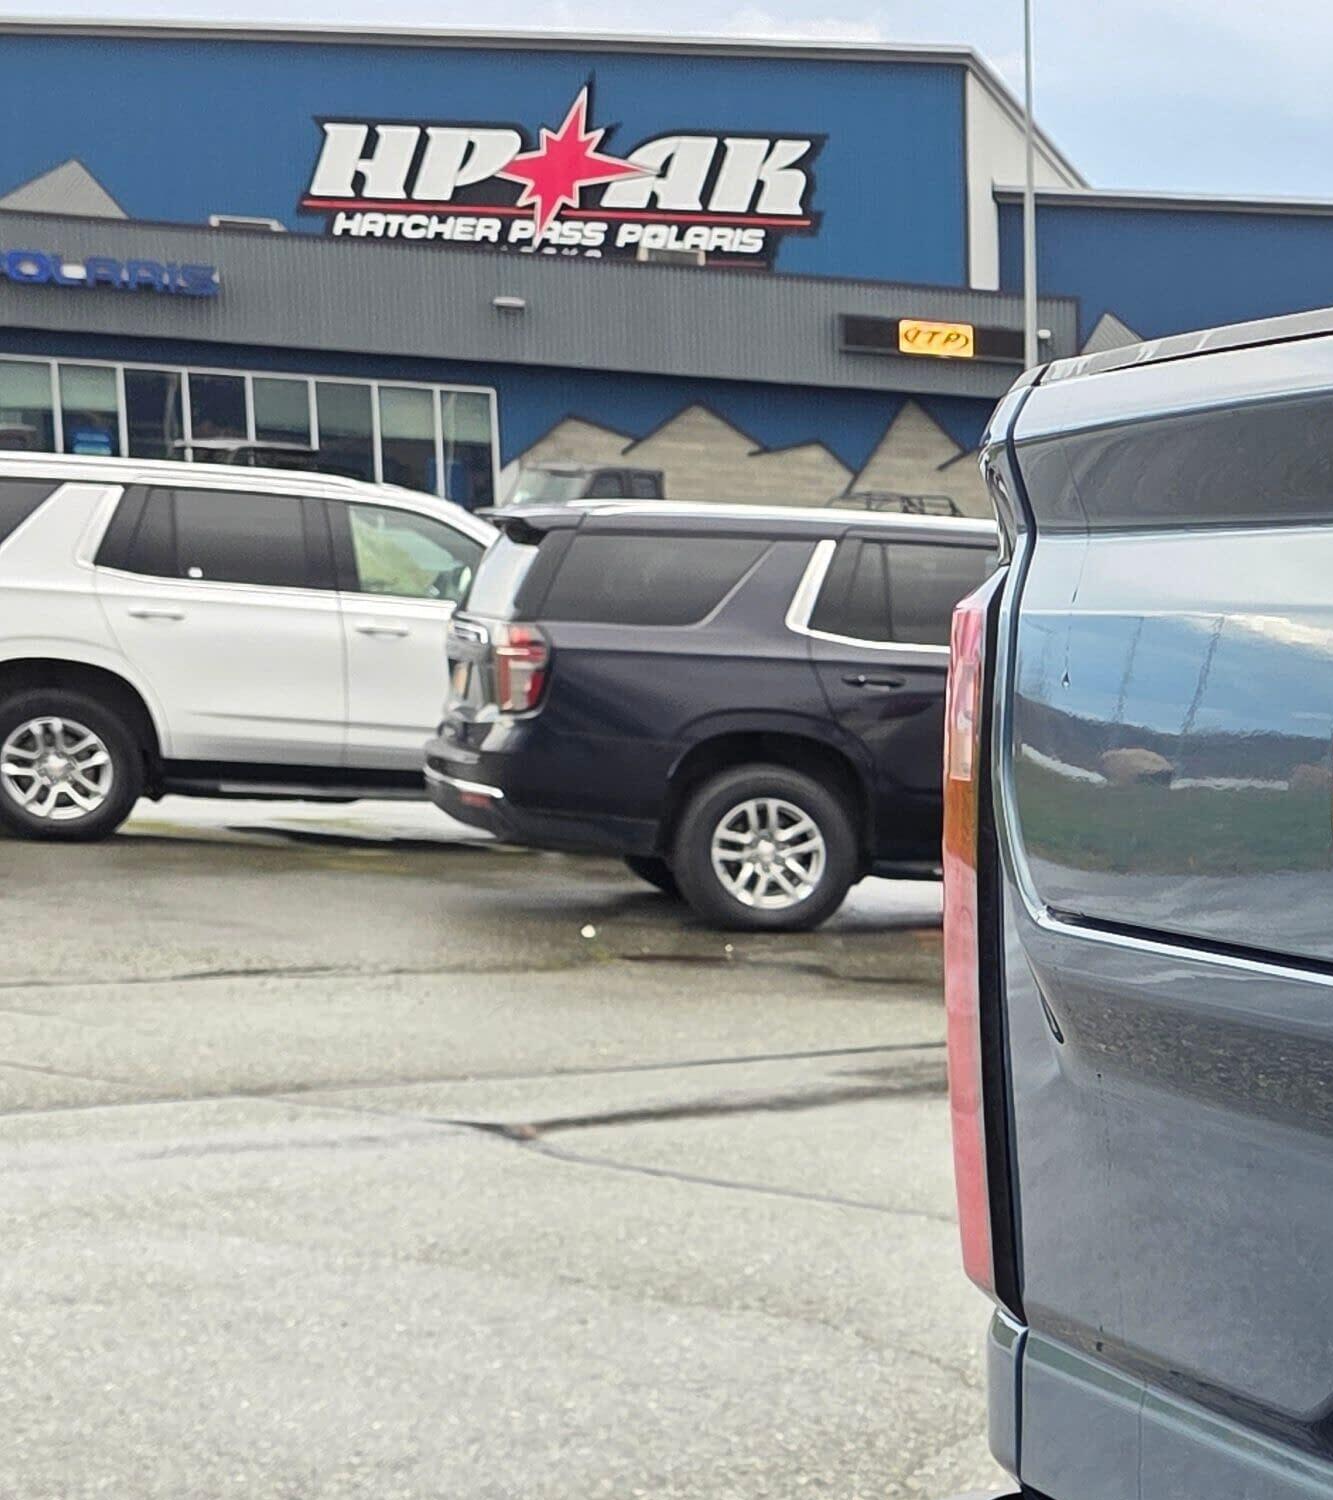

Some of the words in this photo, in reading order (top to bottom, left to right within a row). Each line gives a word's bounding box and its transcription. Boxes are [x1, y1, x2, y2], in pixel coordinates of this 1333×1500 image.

[310, 122, 521, 201] HP
[601, 136, 811, 216] AK
[333, 212, 502, 242] HATCHER
[508, 218, 608, 247] PASS
[615, 222, 766, 254] POLARIS
[0, 251, 220, 297] OLARIS
